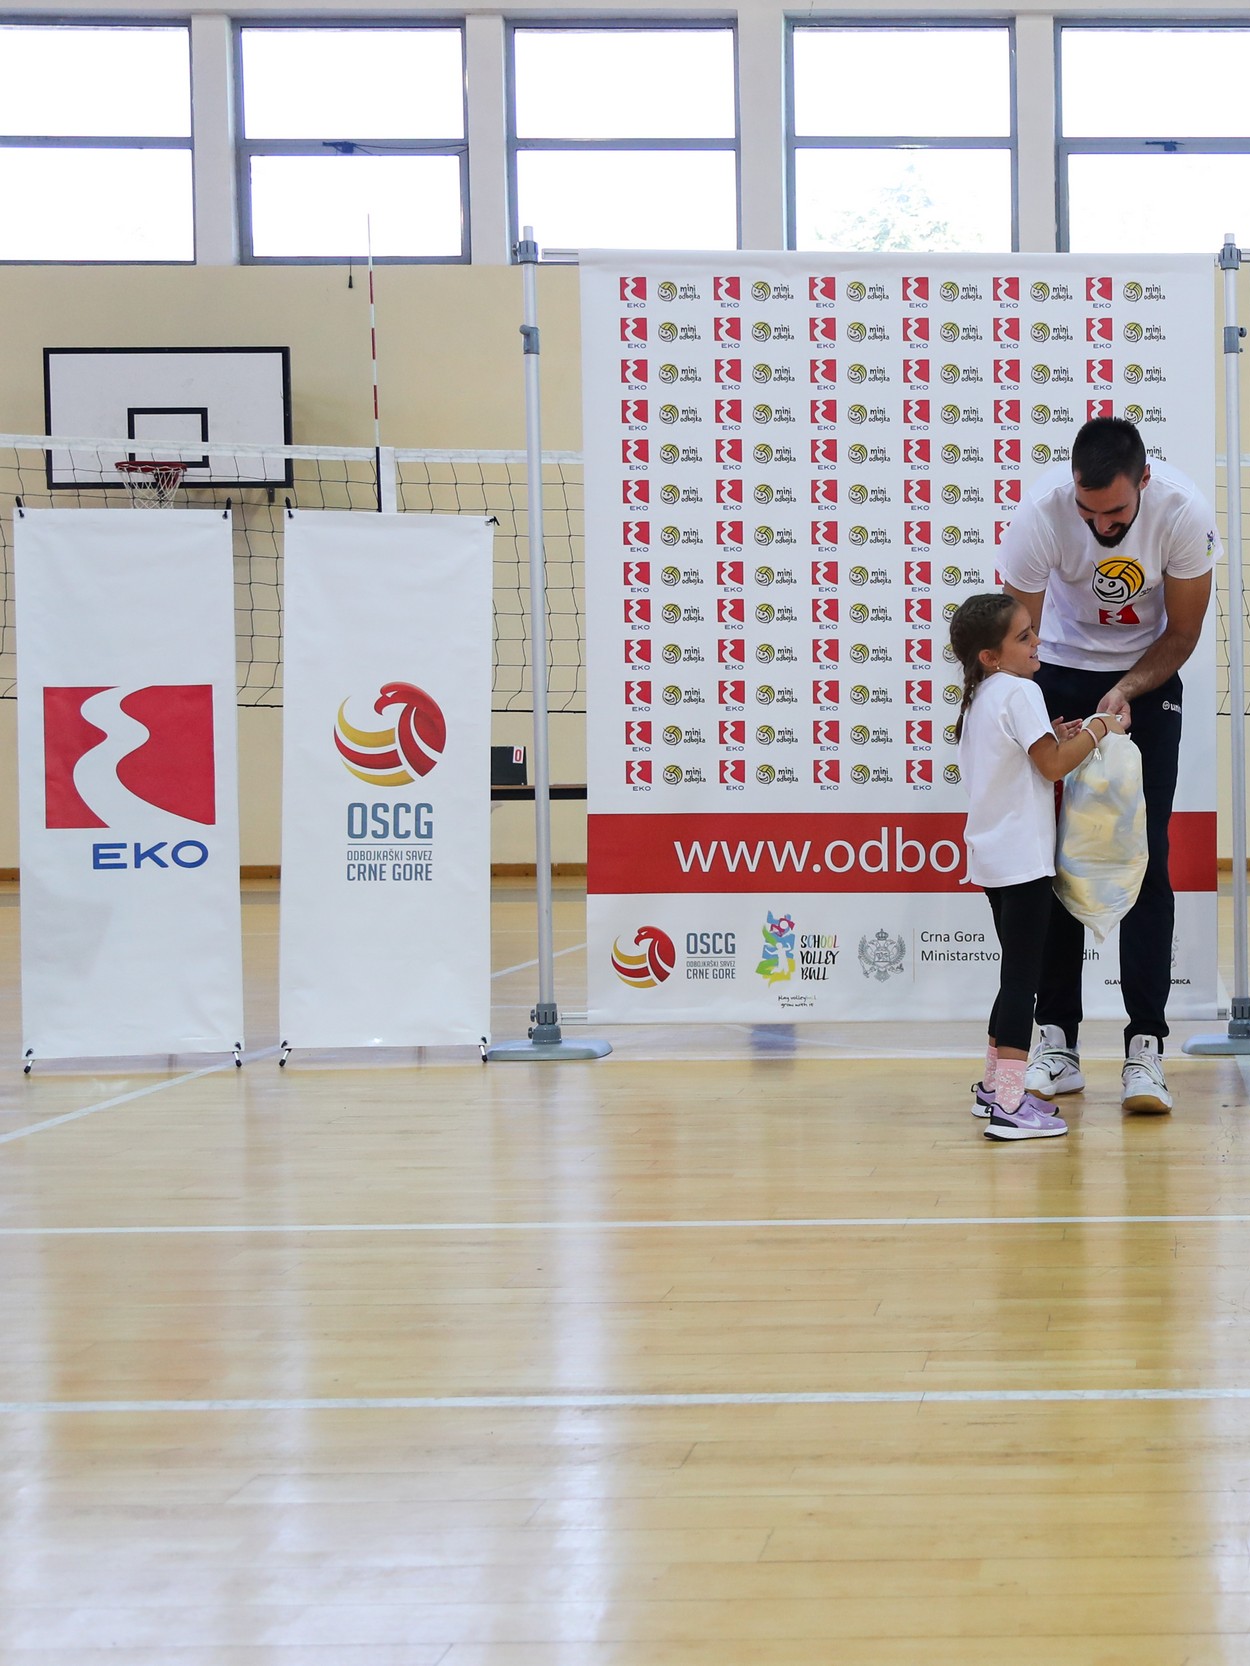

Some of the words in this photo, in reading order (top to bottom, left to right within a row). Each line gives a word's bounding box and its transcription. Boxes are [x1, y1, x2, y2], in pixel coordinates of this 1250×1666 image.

[347, 802, 433, 839] OSCG
[92, 840, 209, 870] EKO
[347, 848, 403, 861] ODBOJKAŠKI
[405, 850, 433, 861] SAVEZ
[673, 826, 972, 885] www.odboj
[347, 863, 387, 881] CRNE
[392, 863, 433, 881] GORE
[686, 932, 736, 954] OSCG
[801, 935, 839, 948] SCHOOL
[920, 931, 950, 943] Crna
[954, 931, 985, 943] Gora
[800, 951, 840, 965] VOLLEY
[920, 949, 1001, 962] Ministarstvo
[687, 968, 710, 979] CRNE
[712, 968, 736, 979] GORE
